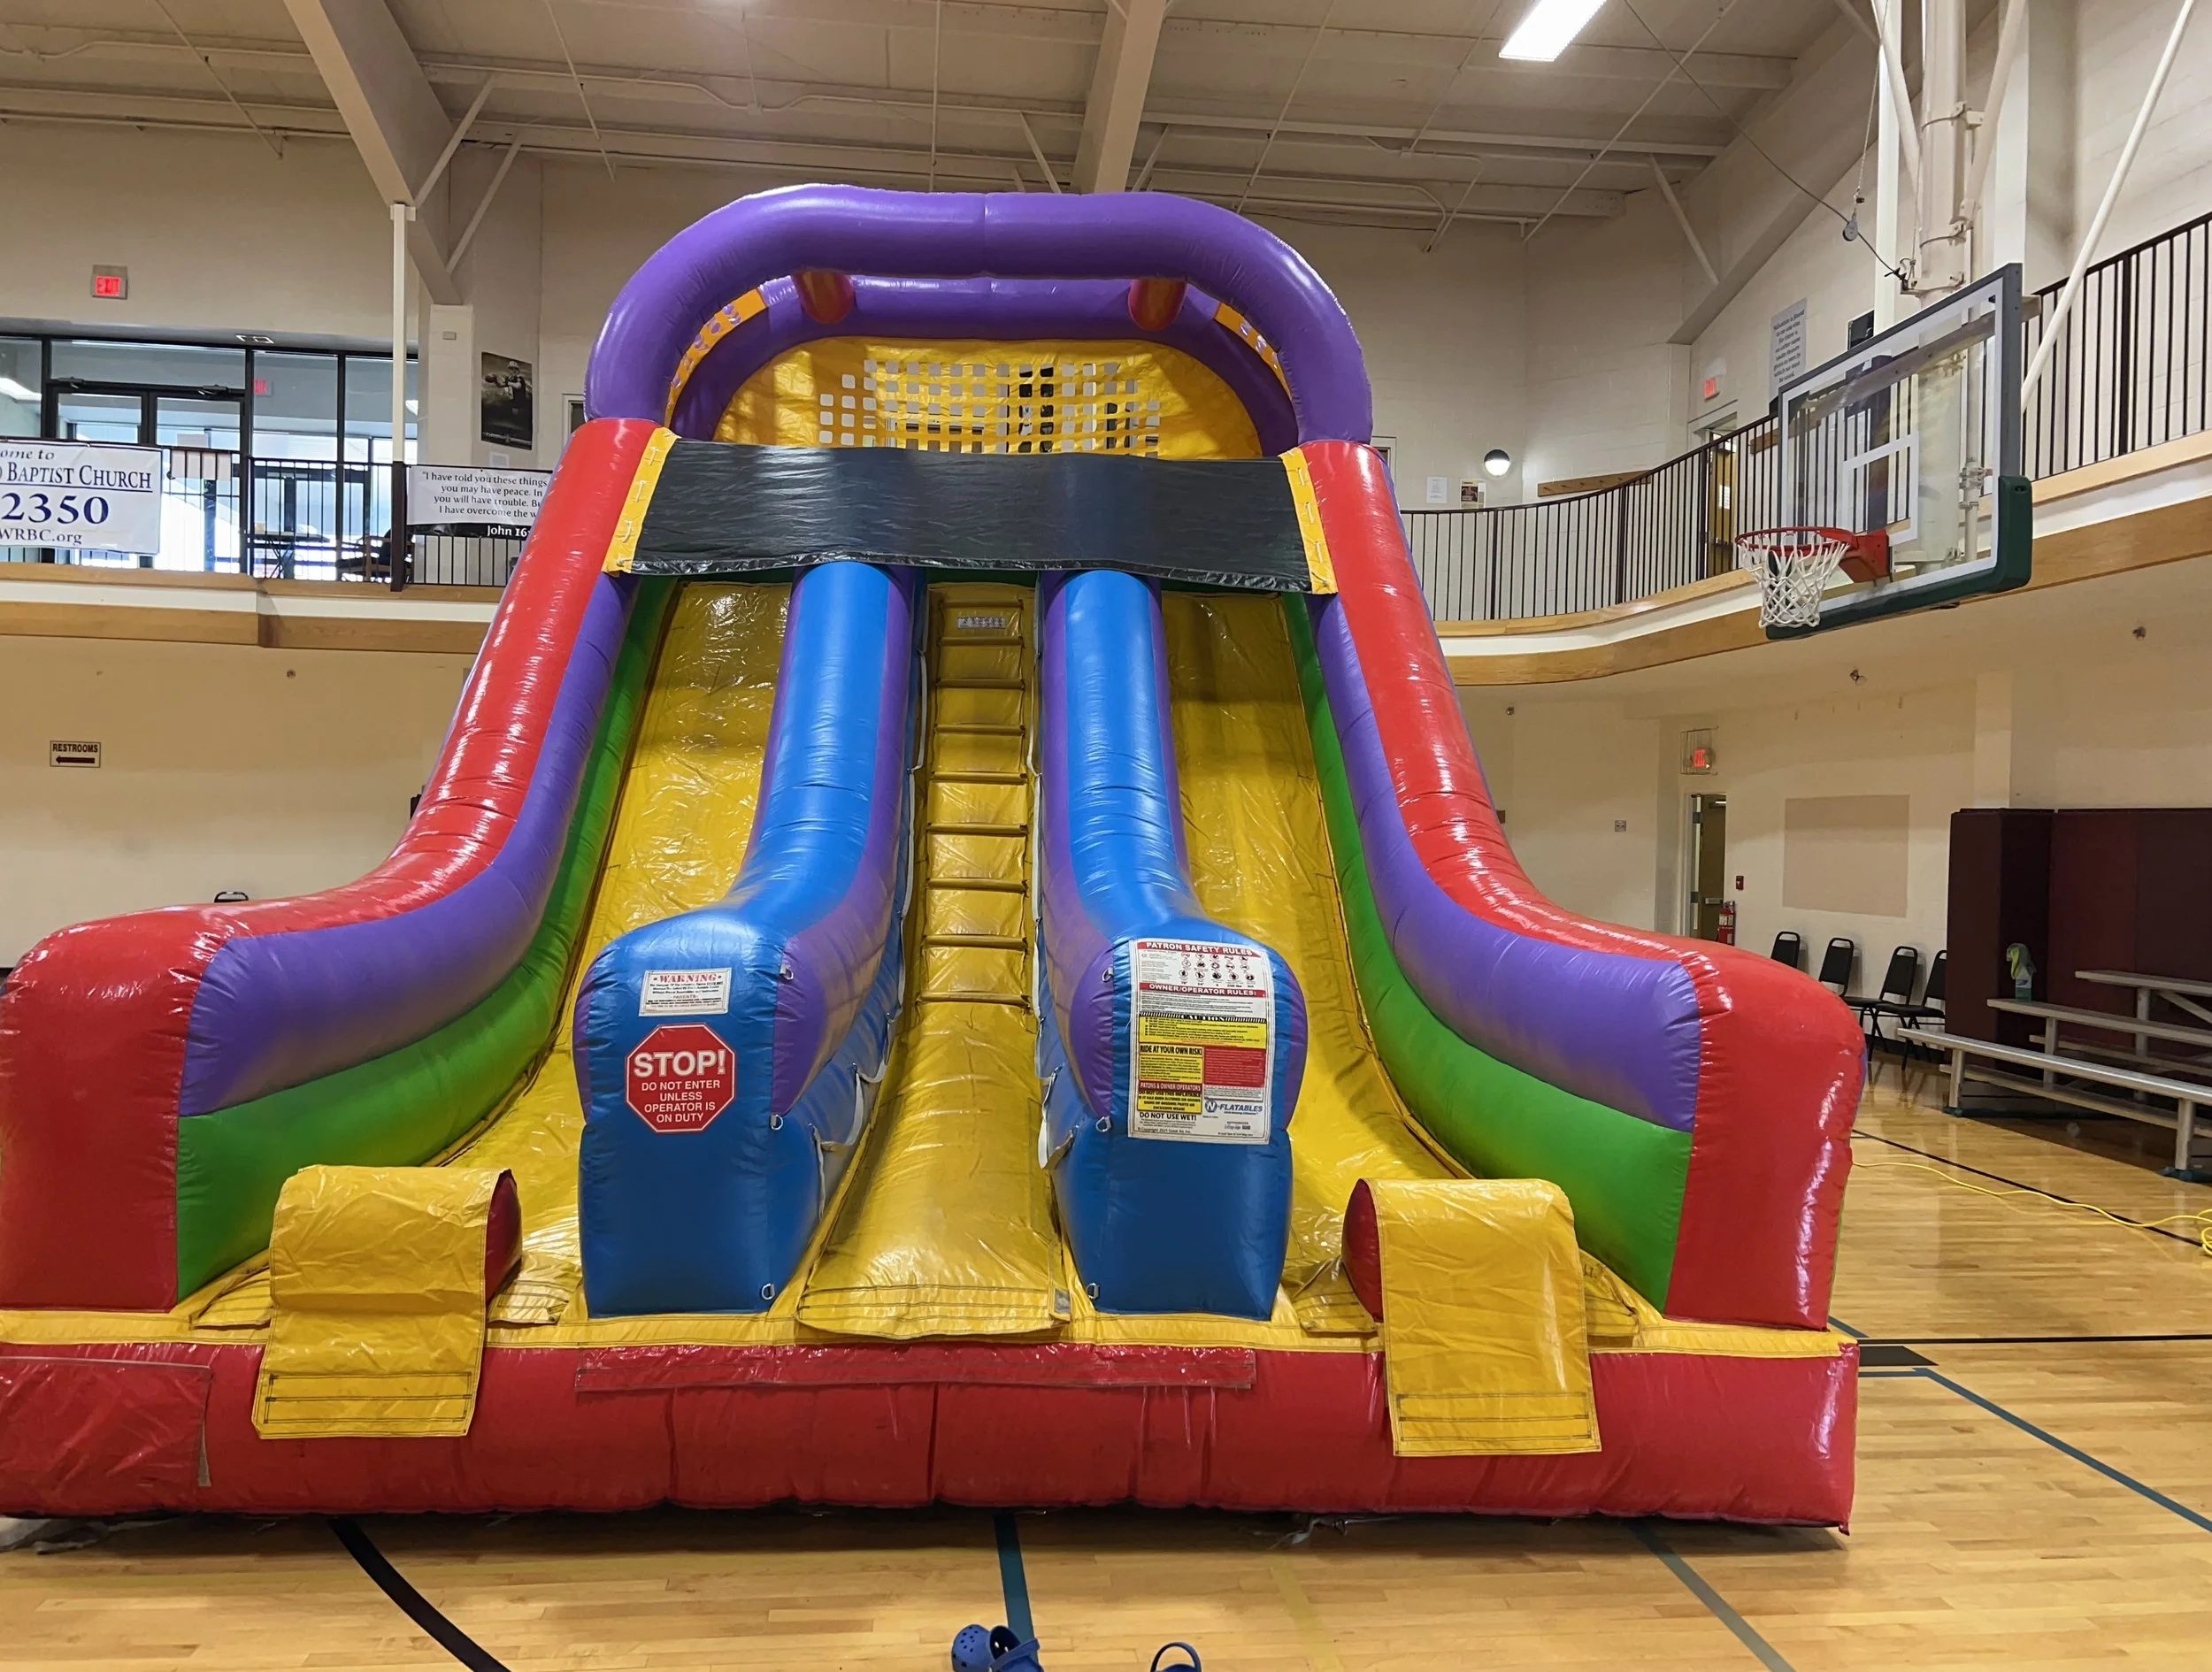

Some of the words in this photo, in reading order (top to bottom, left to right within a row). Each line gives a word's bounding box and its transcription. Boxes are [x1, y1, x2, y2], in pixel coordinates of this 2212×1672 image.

[38, 449, 55, 460] to
[431, 472, 452, 482] have
[454, 472, 472, 483] told
[474, 476, 492, 485] you
[493, 475, 517, 486] these
[518, 476, 548, 487] things
[441, 485, 458, 494] you
[460, 486, 479, 495] may
[480, 486, 502, 495] have
[503, 487, 531, 498] peace.
[534, 488, 542, 497] In
[434, 495, 451, 505] you
[453, 495, 469, 504] will
[471, 495, 492, 505] have
[494, 497, 529, 508] trouble.
[1, 492, 109, 525] 2350
[444, 506, 465, 515] have
[466, 508, 511, 518] overcome
[513, 509, 528, 518] the
[487, 525, 512, 537] John
[52, 743, 98, 753] RESTROOMS
[1146, 941, 1183, 951] PATRON
[1185, 944, 1220, 954] SAFETY
[1222, 947, 1253, 956] RULES
[1148, 984, 1225, 995] OWNER/OPERATOR
[634, 1049, 726, 1078] STOP!
[641, 1081, 657, 1092] DO
[659, 1080, 682, 1091] NOT
[685, 1079, 720, 1090] ENTER
[659, 1091, 703, 1101] UNLESS
[644, 1102, 703, 1113] OPERATOR
[705, 1101, 715, 1111] IS
[656, 1113, 672, 1124] ON
[675, 1112, 703, 1123] DUTY
